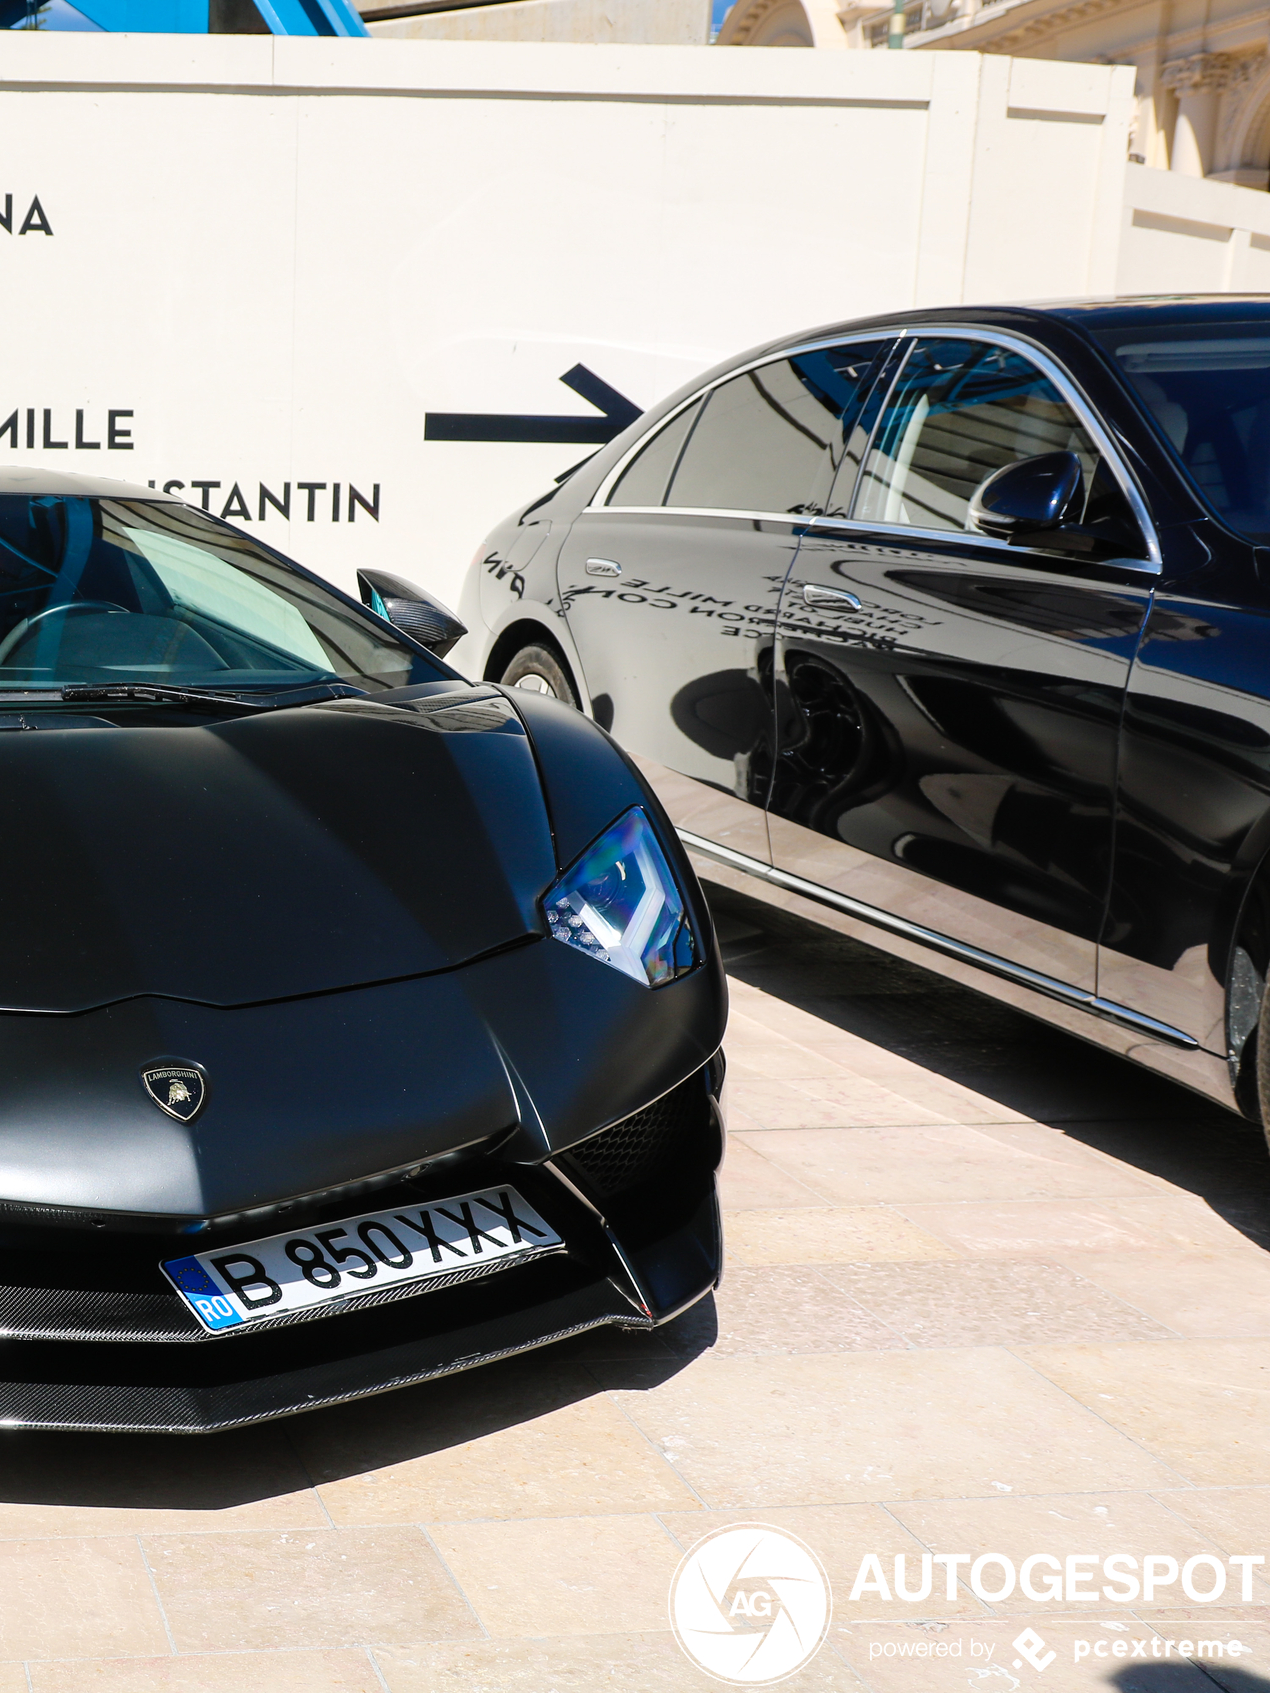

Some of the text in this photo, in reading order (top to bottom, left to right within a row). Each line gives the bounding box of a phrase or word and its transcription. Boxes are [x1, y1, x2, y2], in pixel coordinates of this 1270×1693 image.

[148, 1070, 198, 1082] LAMBORGHINI
[209, 1253, 283, 1311] B
[197, 1295, 234, 1323] RO
